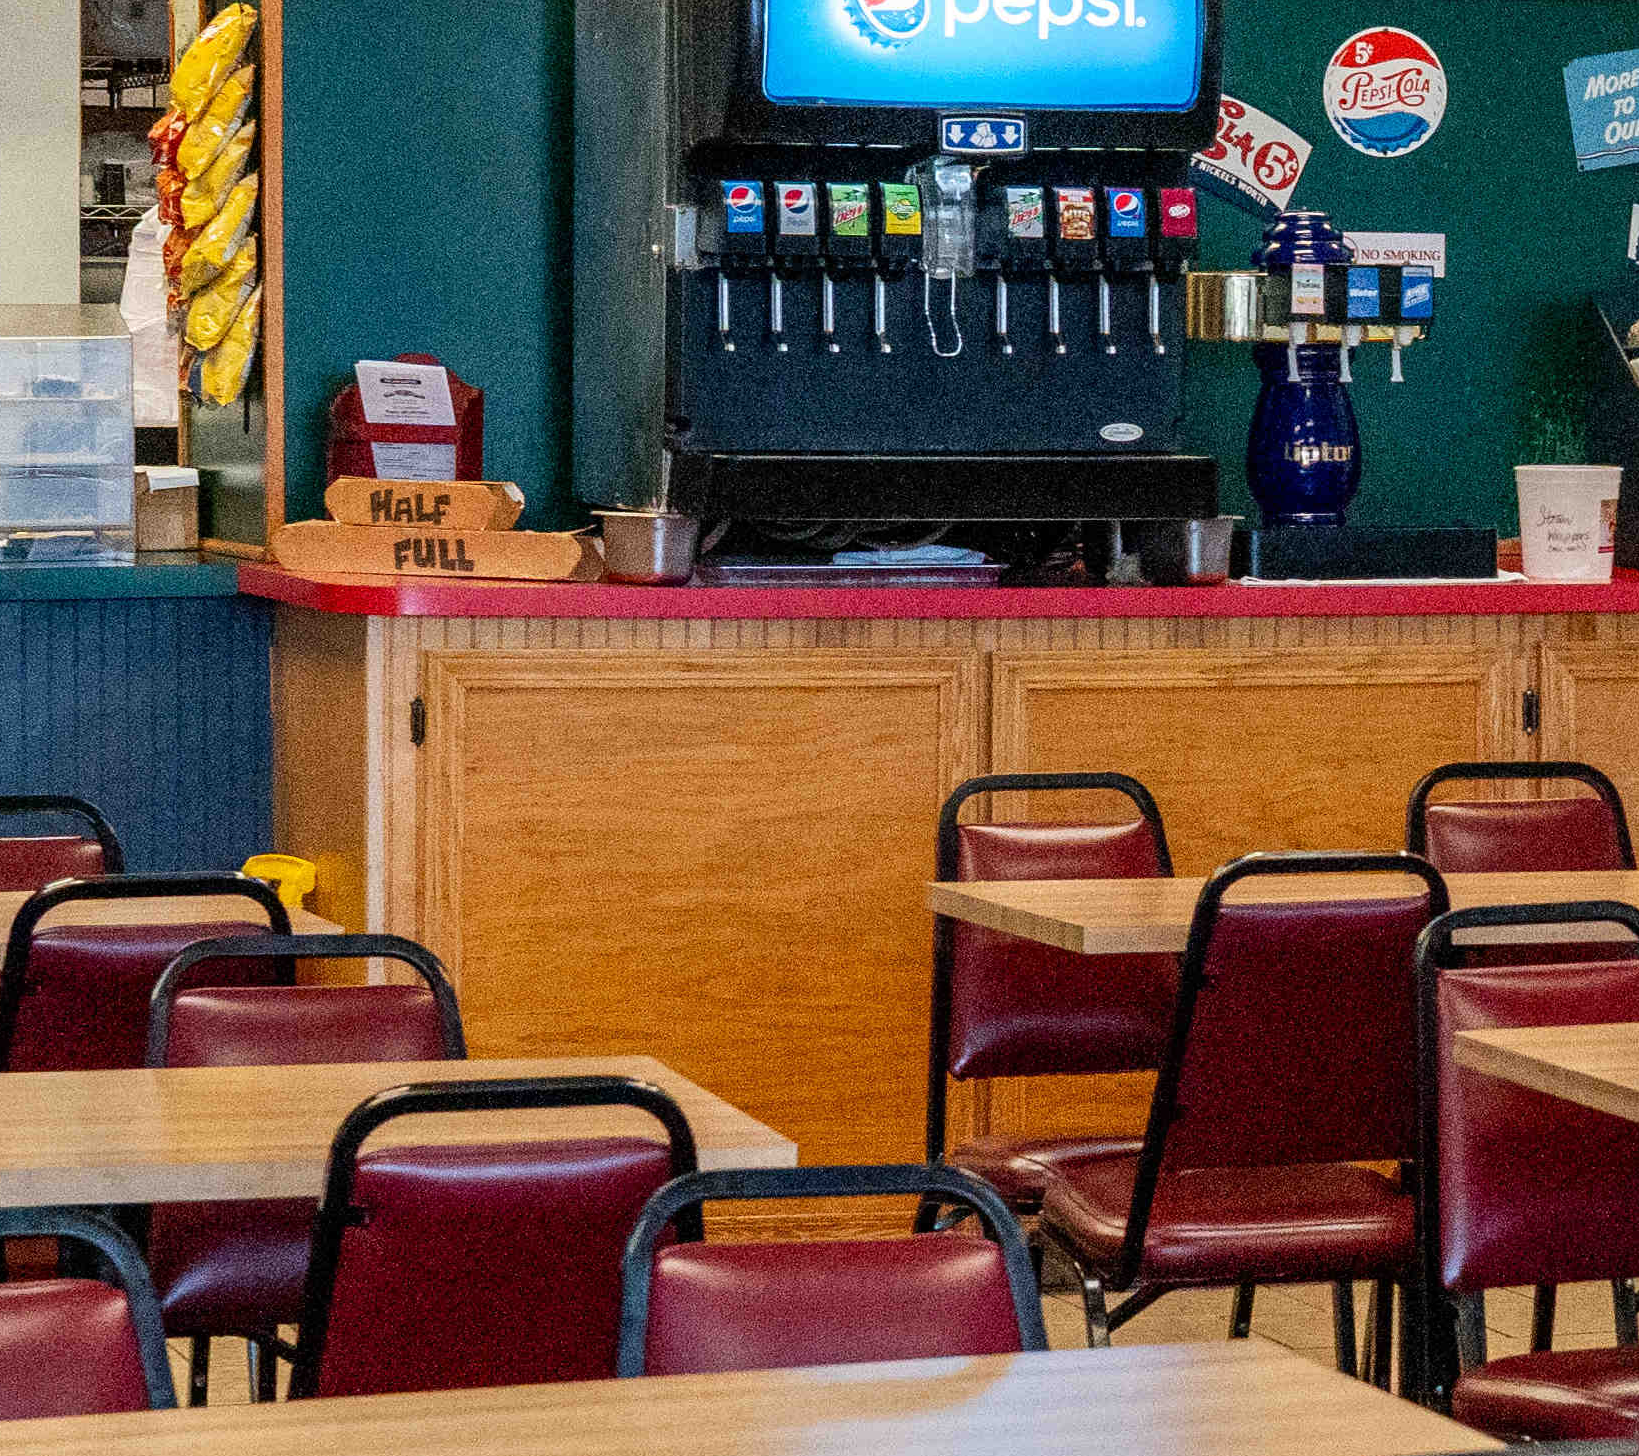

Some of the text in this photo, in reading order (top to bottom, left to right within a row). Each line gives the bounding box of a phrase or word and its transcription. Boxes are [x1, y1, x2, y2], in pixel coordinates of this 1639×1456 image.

[1338, 67, 1431, 111] PEPSI-COLA
[1613, 95, 1636, 117] TO
[1361, 249, 1441, 261] NO SMOKING
[369, 488, 451, 526] HALF
[394, 538, 475, 572] FULL
